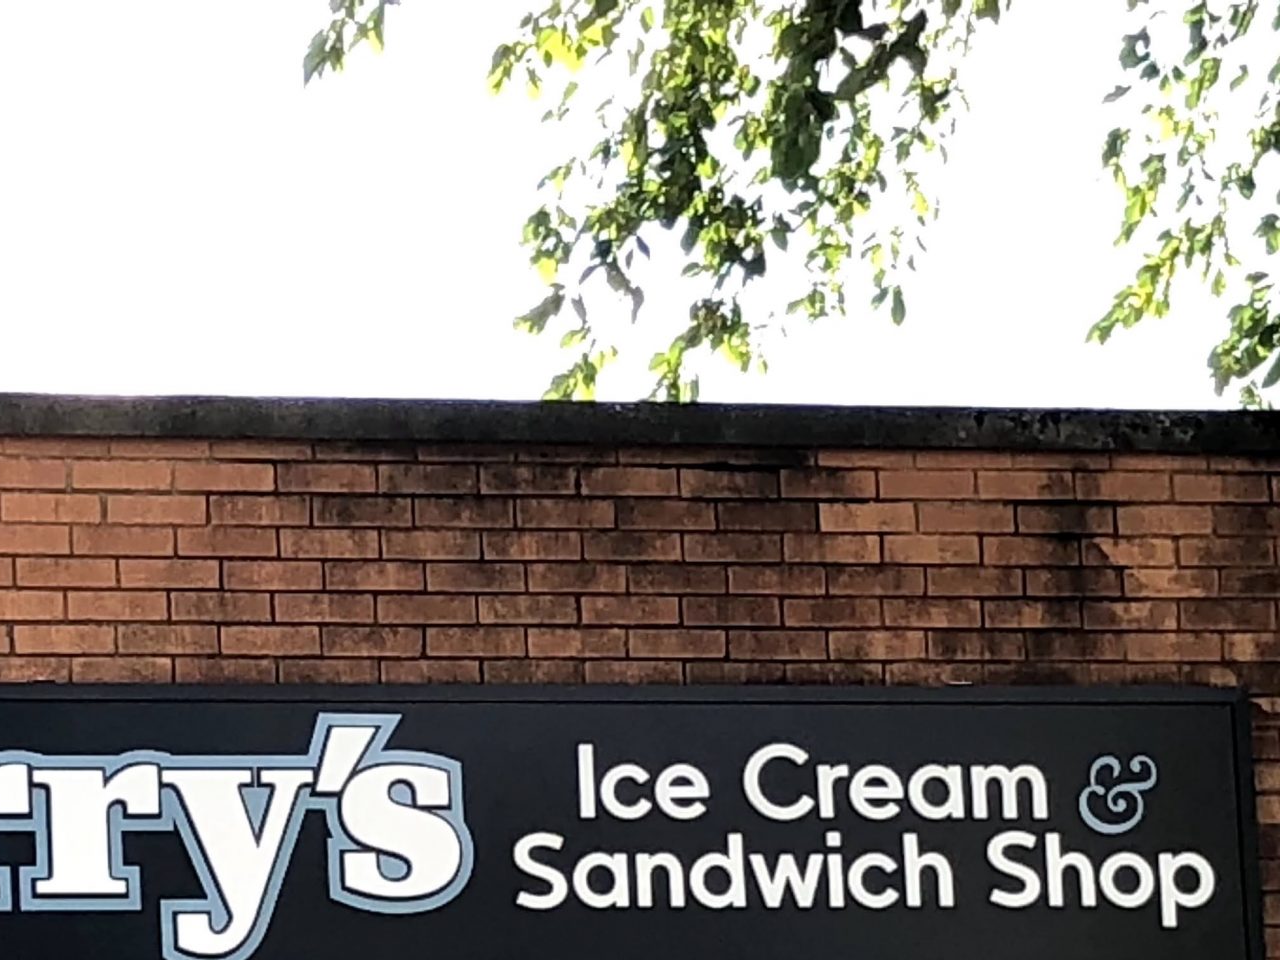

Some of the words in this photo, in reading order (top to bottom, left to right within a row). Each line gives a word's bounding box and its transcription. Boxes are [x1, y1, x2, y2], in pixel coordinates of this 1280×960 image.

[578, 743, 710, 820] Ice
[742, 743, 1049, 821] Cream
[1079, 754, 1158, 834] &
[512, 831, 955, 909] Sandwich
[986, 831, 1216, 928] Shop
